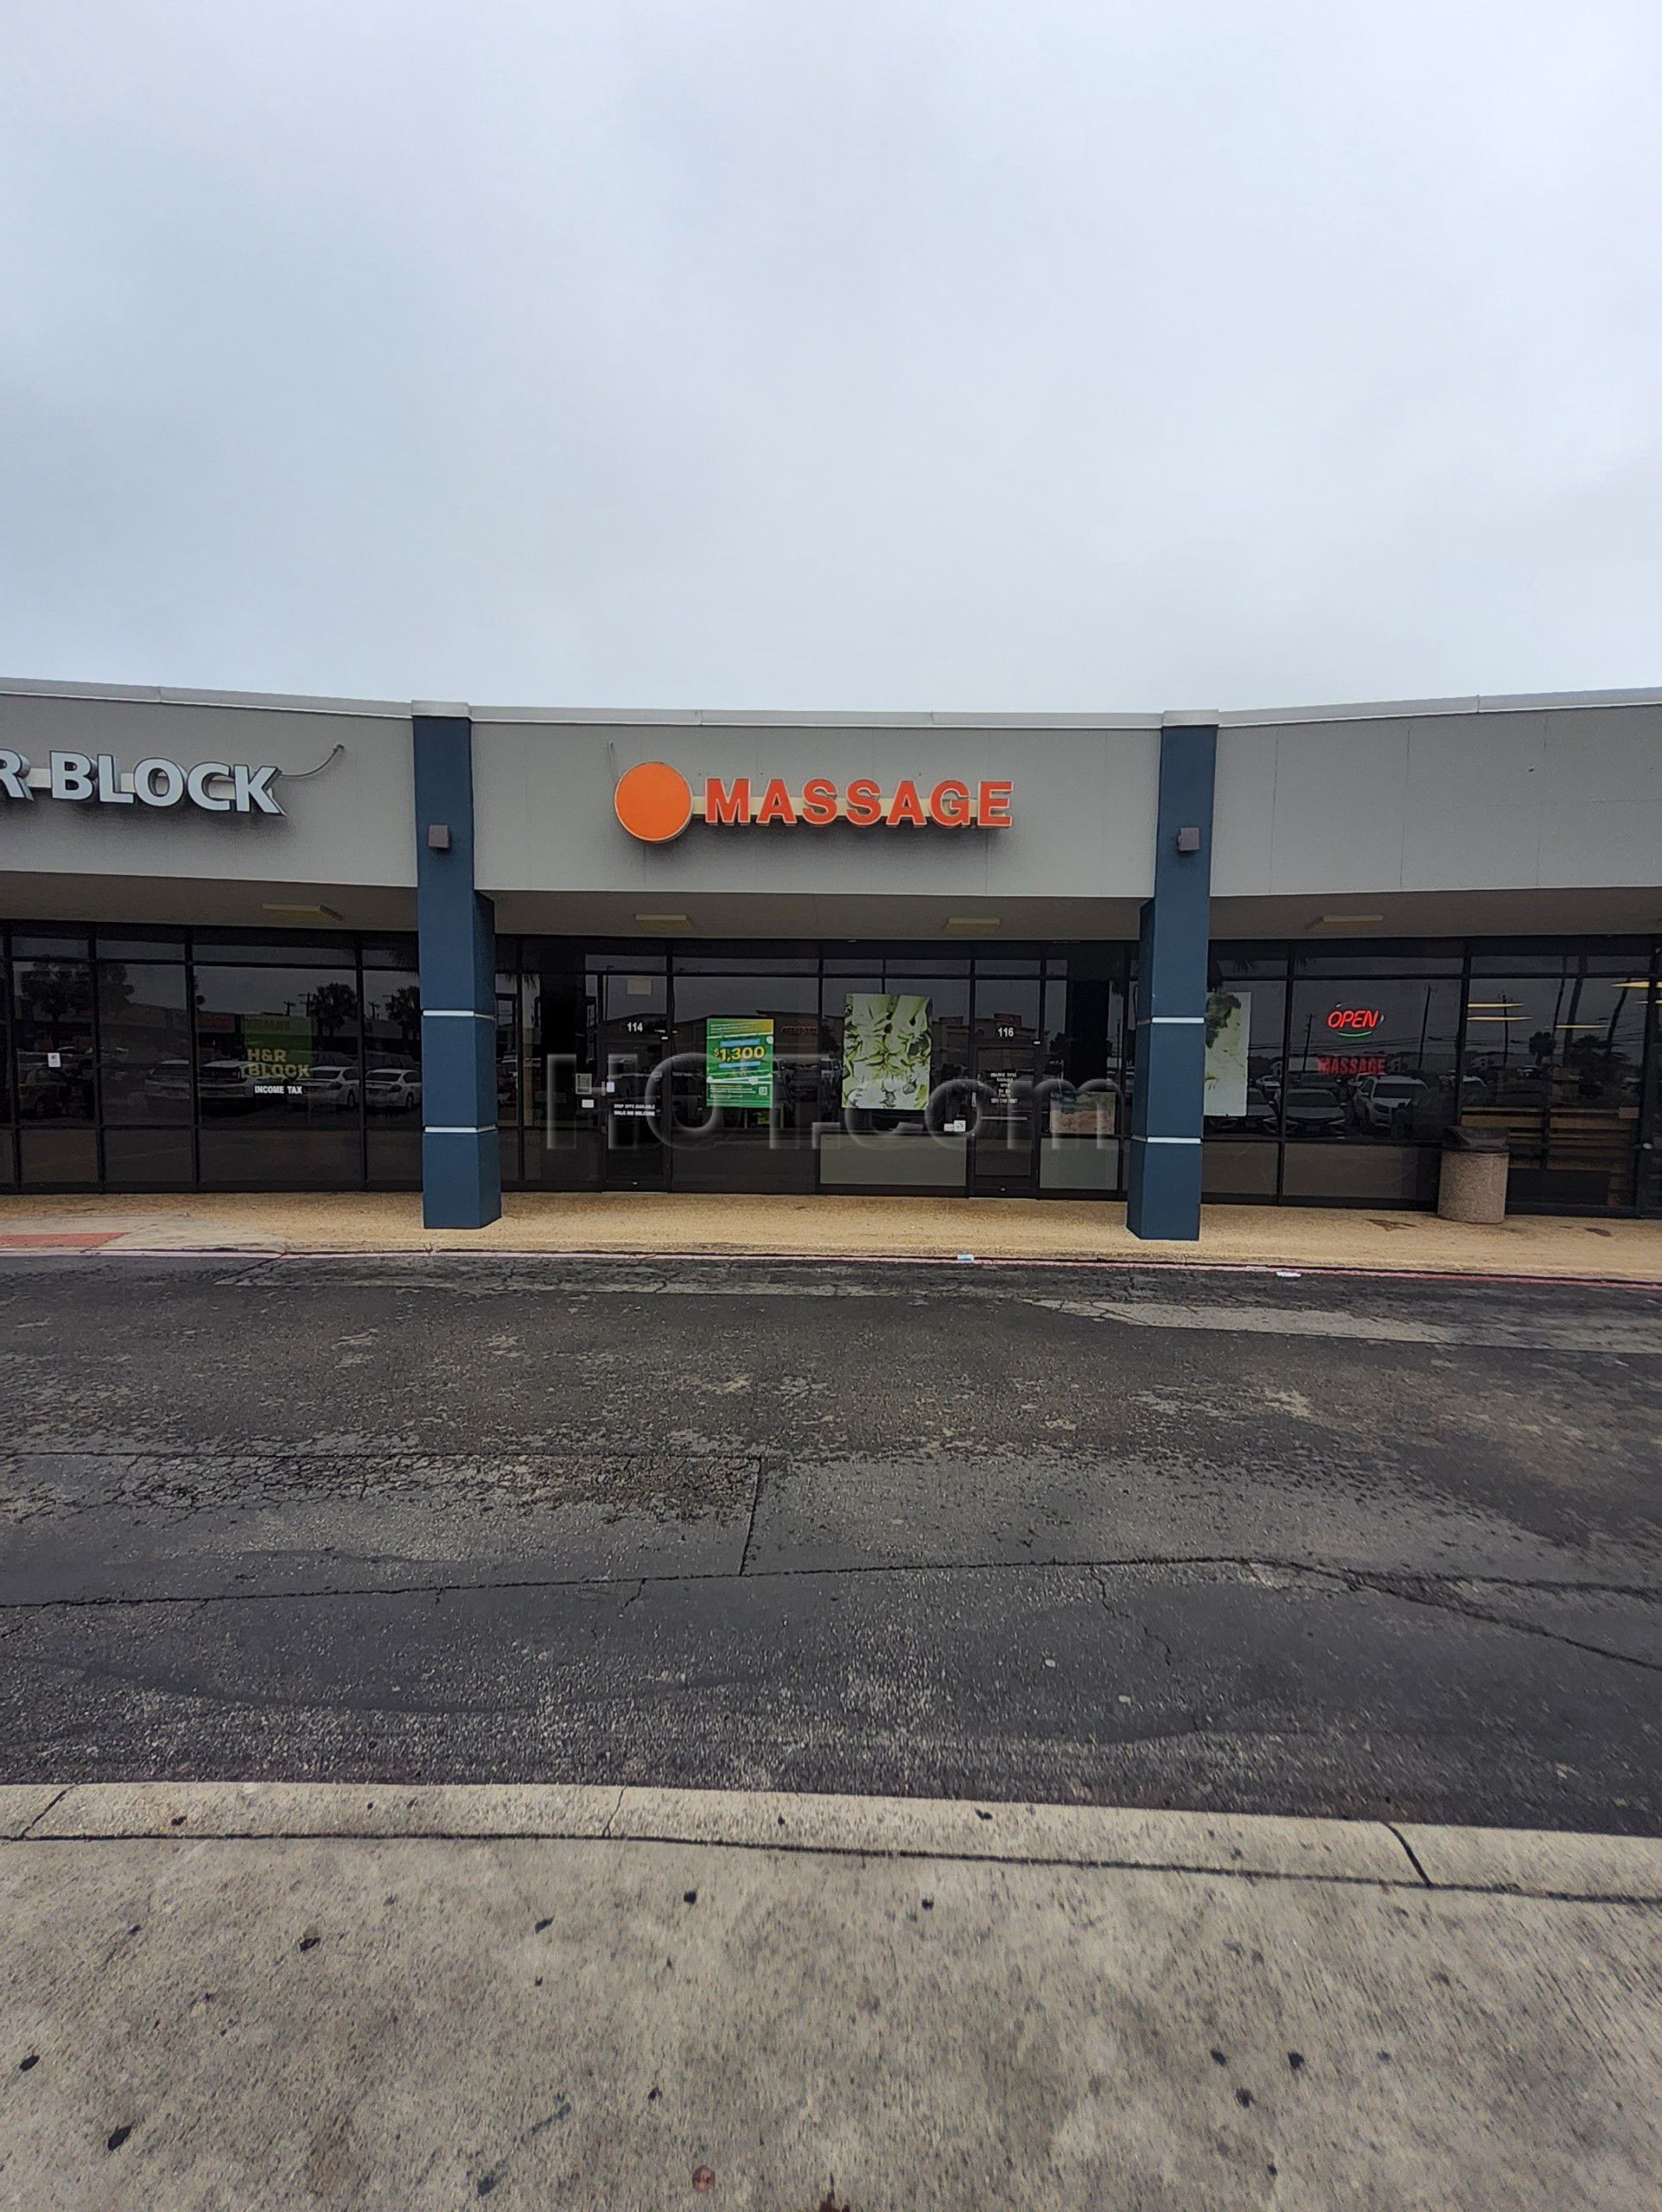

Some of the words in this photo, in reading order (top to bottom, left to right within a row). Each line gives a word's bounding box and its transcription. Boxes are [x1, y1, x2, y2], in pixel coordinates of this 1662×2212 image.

[49, 750, 287, 817] BLOCK
[704, 778, 1014, 827] MASSAGE
[1328, 1009, 1379, 1028] OPEN
[627, 1021, 643, 1032] 114
[997, 1027, 1015, 1037] 116
[247, 1048, 287, 1062] H&R
[713, 1046, 766, 1062] $1,300
[247, 1064, 311, 1078] BLOCK
[1317, 1055, 1386, 1075] MASSAGE
[254, 1085, 285, 1094] INCOME
[287, 1085, 302, 1094] TAX
